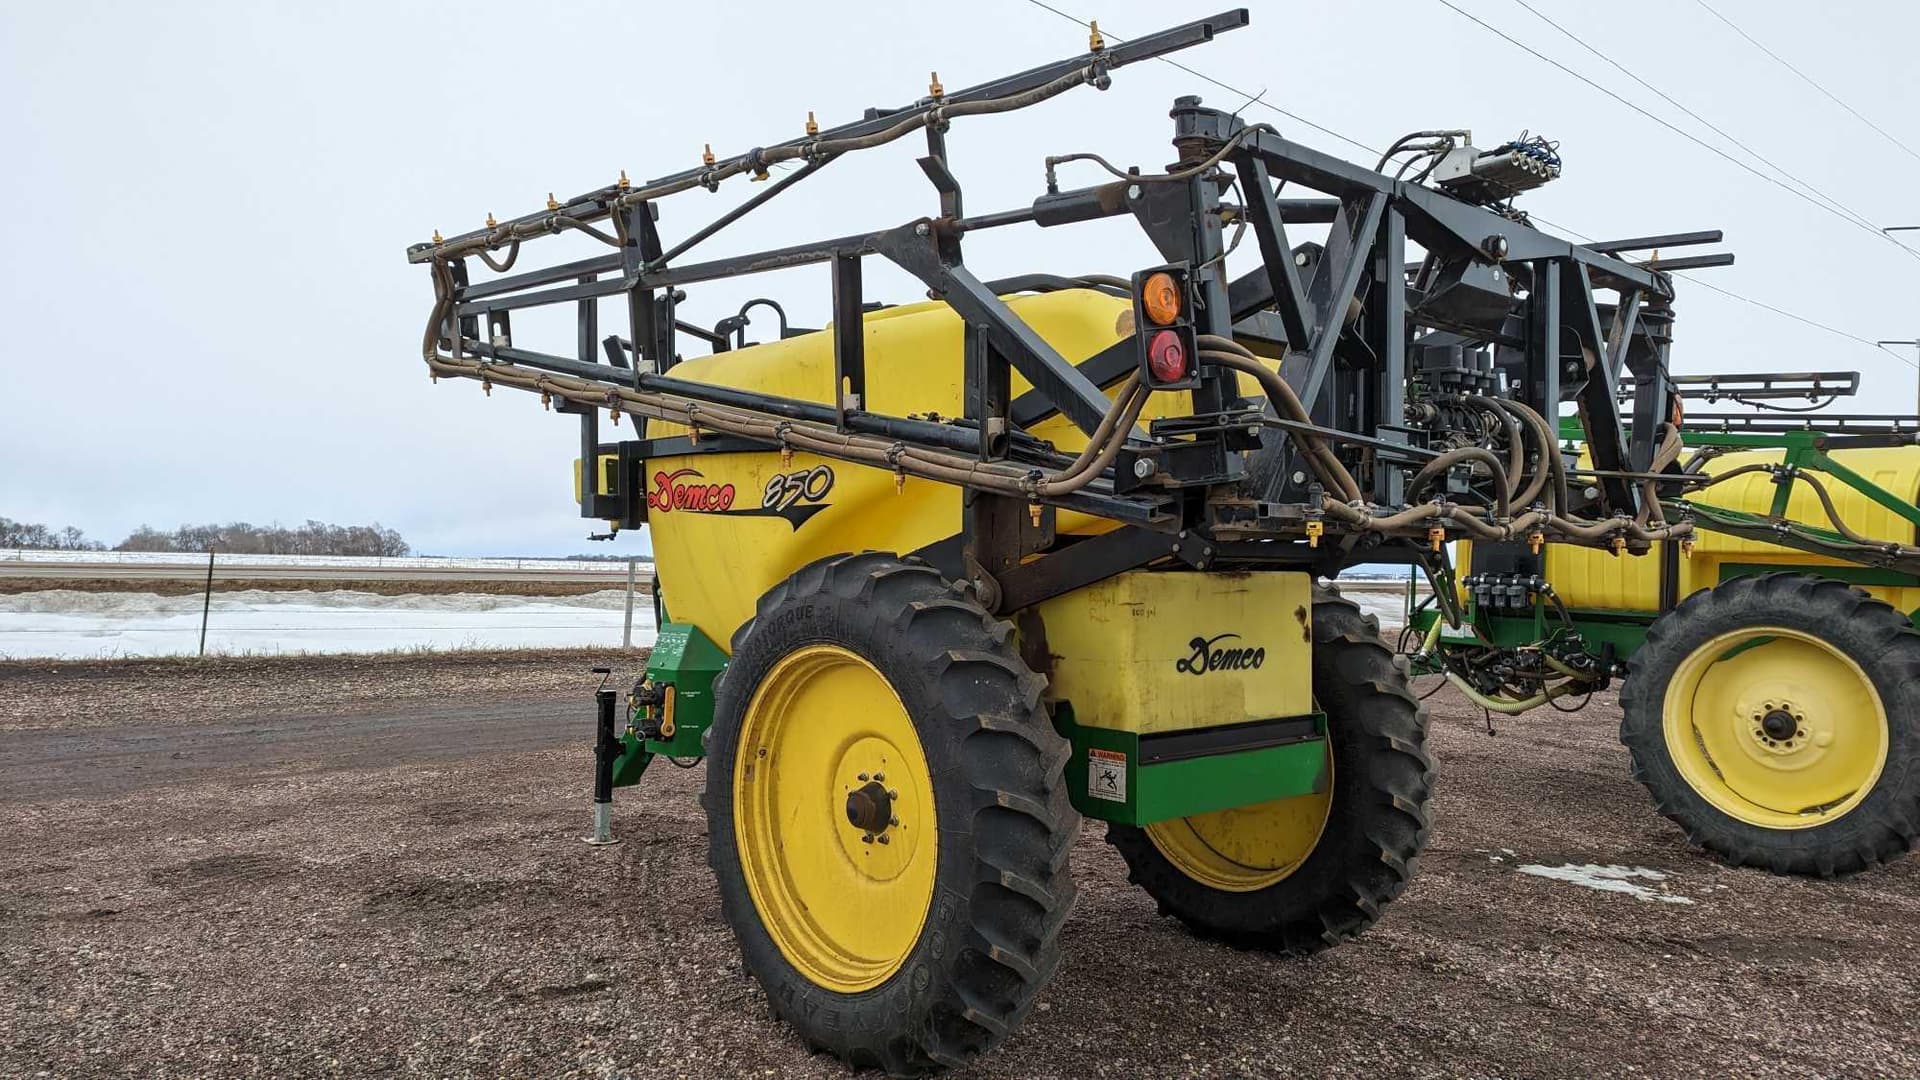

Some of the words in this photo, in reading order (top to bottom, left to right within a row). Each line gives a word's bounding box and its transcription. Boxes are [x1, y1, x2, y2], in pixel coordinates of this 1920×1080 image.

[648, 468, 736, 513] Demco
[762, 464, 835, 513] 850
[1176, 633, 1265, 676] Demco
